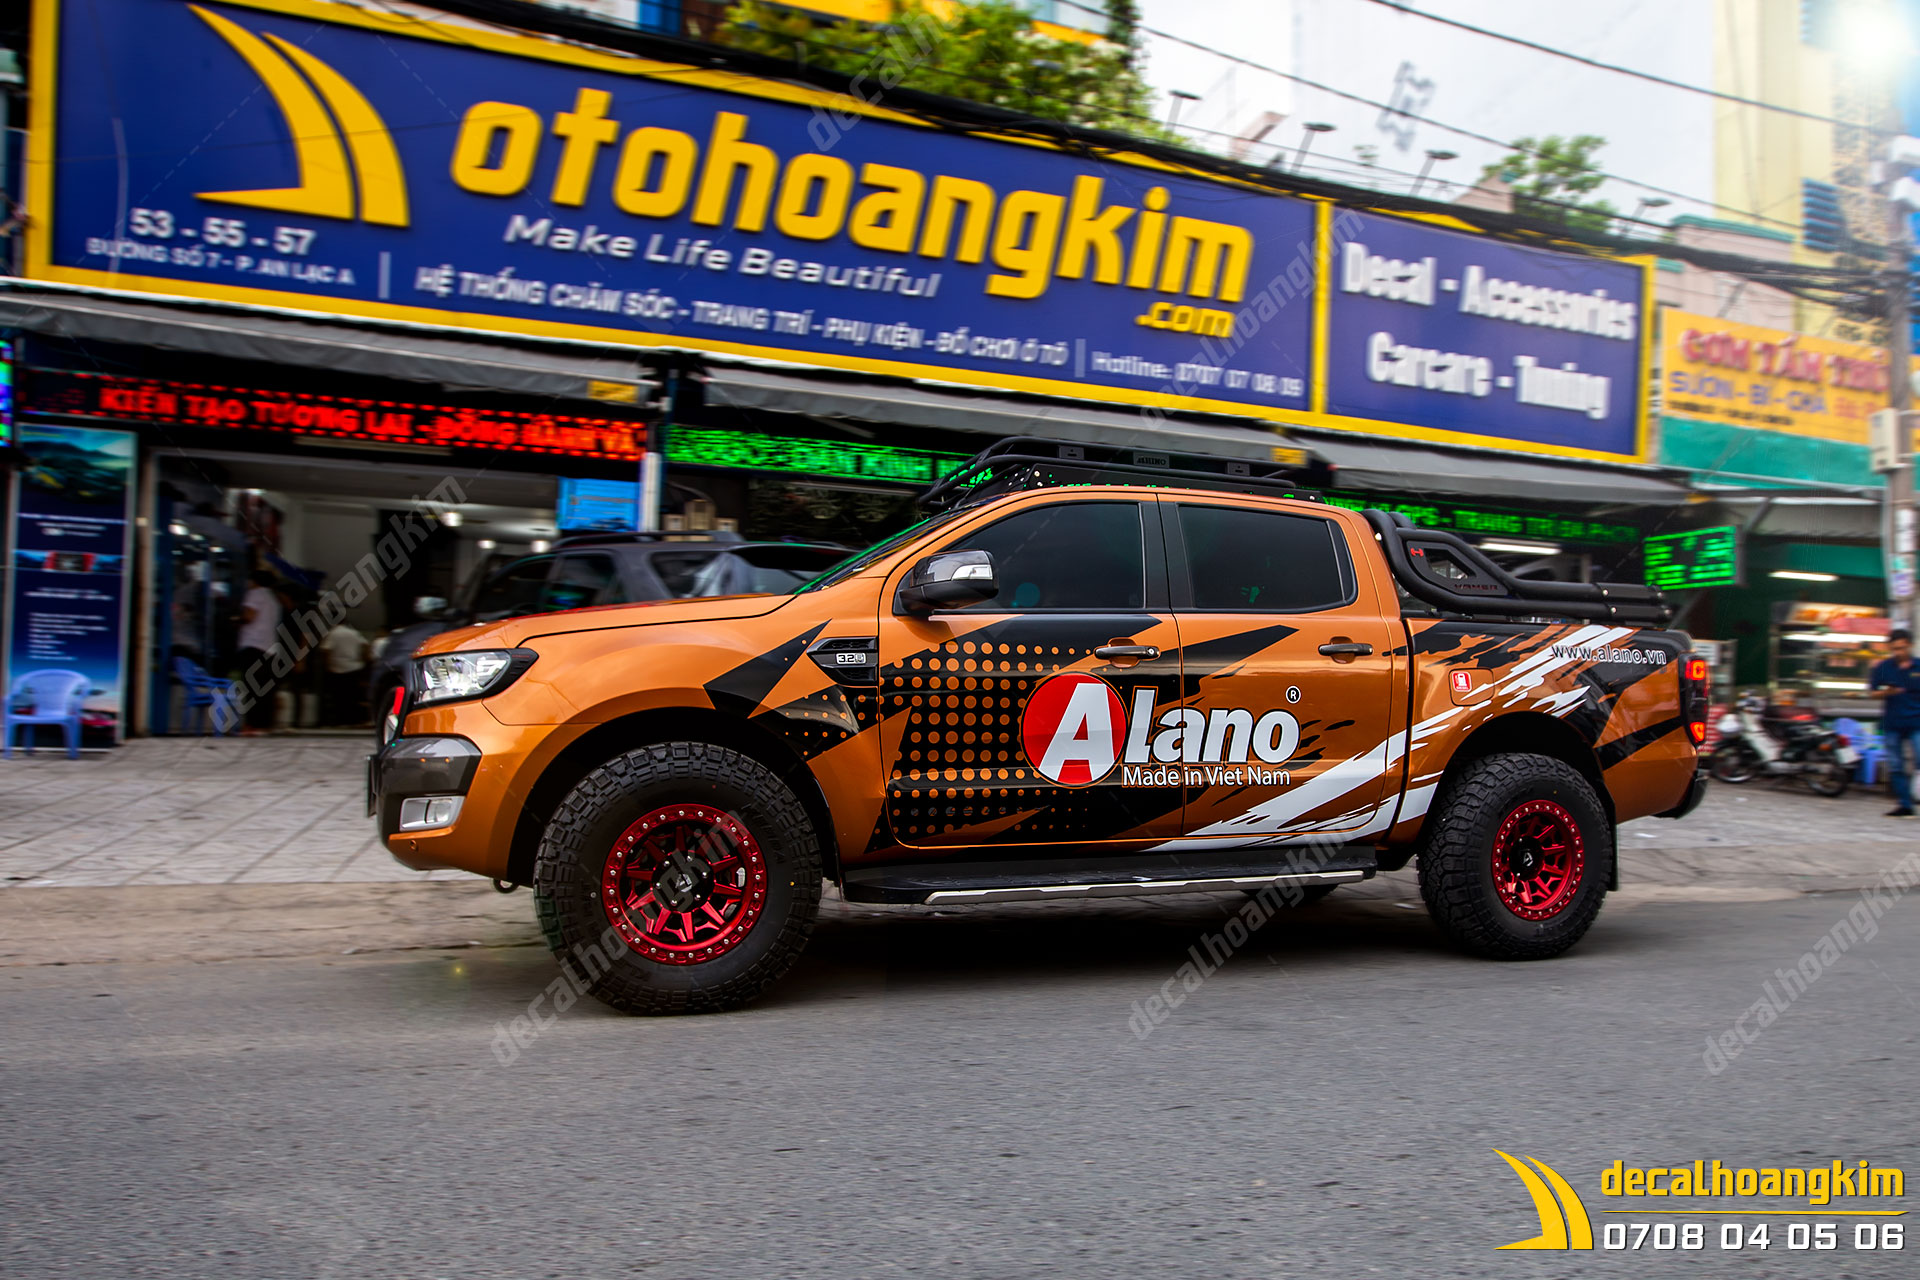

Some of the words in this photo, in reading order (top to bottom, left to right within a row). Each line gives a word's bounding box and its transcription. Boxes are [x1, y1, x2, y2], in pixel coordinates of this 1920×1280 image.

[450, 87, 1254, 302] otohoangkim
[130, 207, 174, 238] 53
[203, 217, 246, 247] 55
[273, 226, 316, 255] 57
[503, 214, 638, 259] Make
[644, 233, 733, 271] Life
[738, 247, 942, 298] Beautiful
[1341, 242, 1437, 306] Decal
[1458, 264, 1637, 340] Accessories
[691, 300, 770, 331] TRANG
[1135, 301, 1236, 339] .com
[1090, 349, 1174, 381] Hotline:
[1367, 331, 1493, 397] Carcare
[1550, 643, 1668, 666] www.alano.vn
[1037, 683, 1301, 783] Alano
[1122, 765, 1180, 787] Made
[1183, 766, 1202, 787] in
[1203, 766, 1246, 787] Viet
[1247, 767, 1291, 787] Nam
